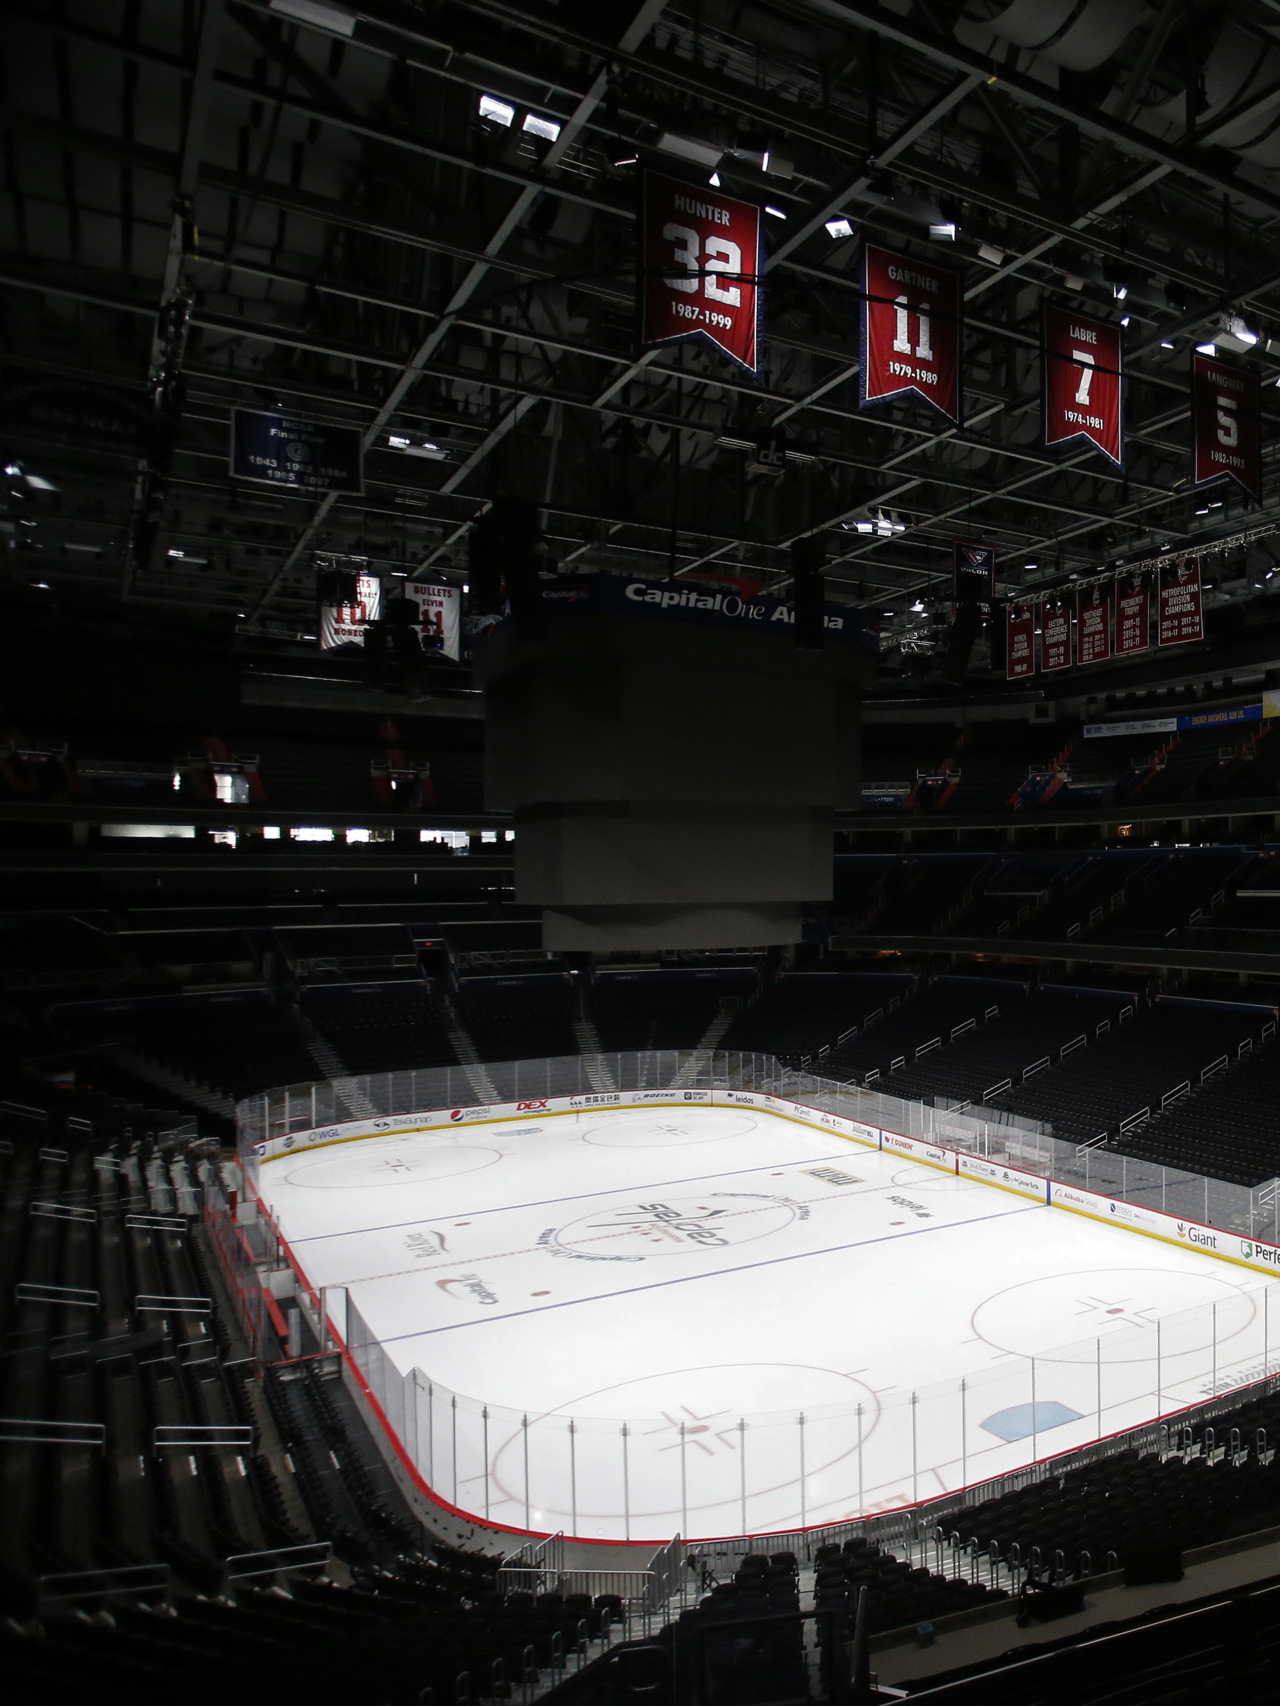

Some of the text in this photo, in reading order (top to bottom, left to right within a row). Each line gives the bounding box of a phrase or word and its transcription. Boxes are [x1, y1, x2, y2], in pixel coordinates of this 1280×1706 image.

[674, 194, 731, 226] HUNTER
[662, 222, 742, 308] 32
[888, 265, 939, 293] GARTNER
[671, 302, 732, 330] 1987-1999
[893, 295, 934, 362] 11
[1069, 324, 1097, 344] LABRE
[889, 362, 939, 386] 1979-1989
[1072, 350, 1096, 406] 7
[1207, 370, 1246, 392] LANGWAY
[1064, 410, 1104, 431] 1974-1981
[1216, 395, 1239, 447] 5
[270, 428, 298, 440] Final
[248, 456, 278, 468] 1943
[960, 567, 989, 576] VALOR
[414, 585, 452, 598] BULLETS
[1161, 583, 1198, 599] METROPOLITAN
[1168, 594, 1191, 606] DIVISION
[422, 599, 444, 608] ELVIN
[1165, 602, 1195, 615] CHAMPIONS
[421, 609, 444, 635] 11
[516, 1100, 549, 1111] DEX
[735, 1094, 754, 1104] leidos
[465, 1107, 491, 1117] pepsi
[319, 1128, 340, 1139] WGL
[1064, 1192, 1085, 1204] Alibaba
[1188, 1227, 1217, 1249] Giant
